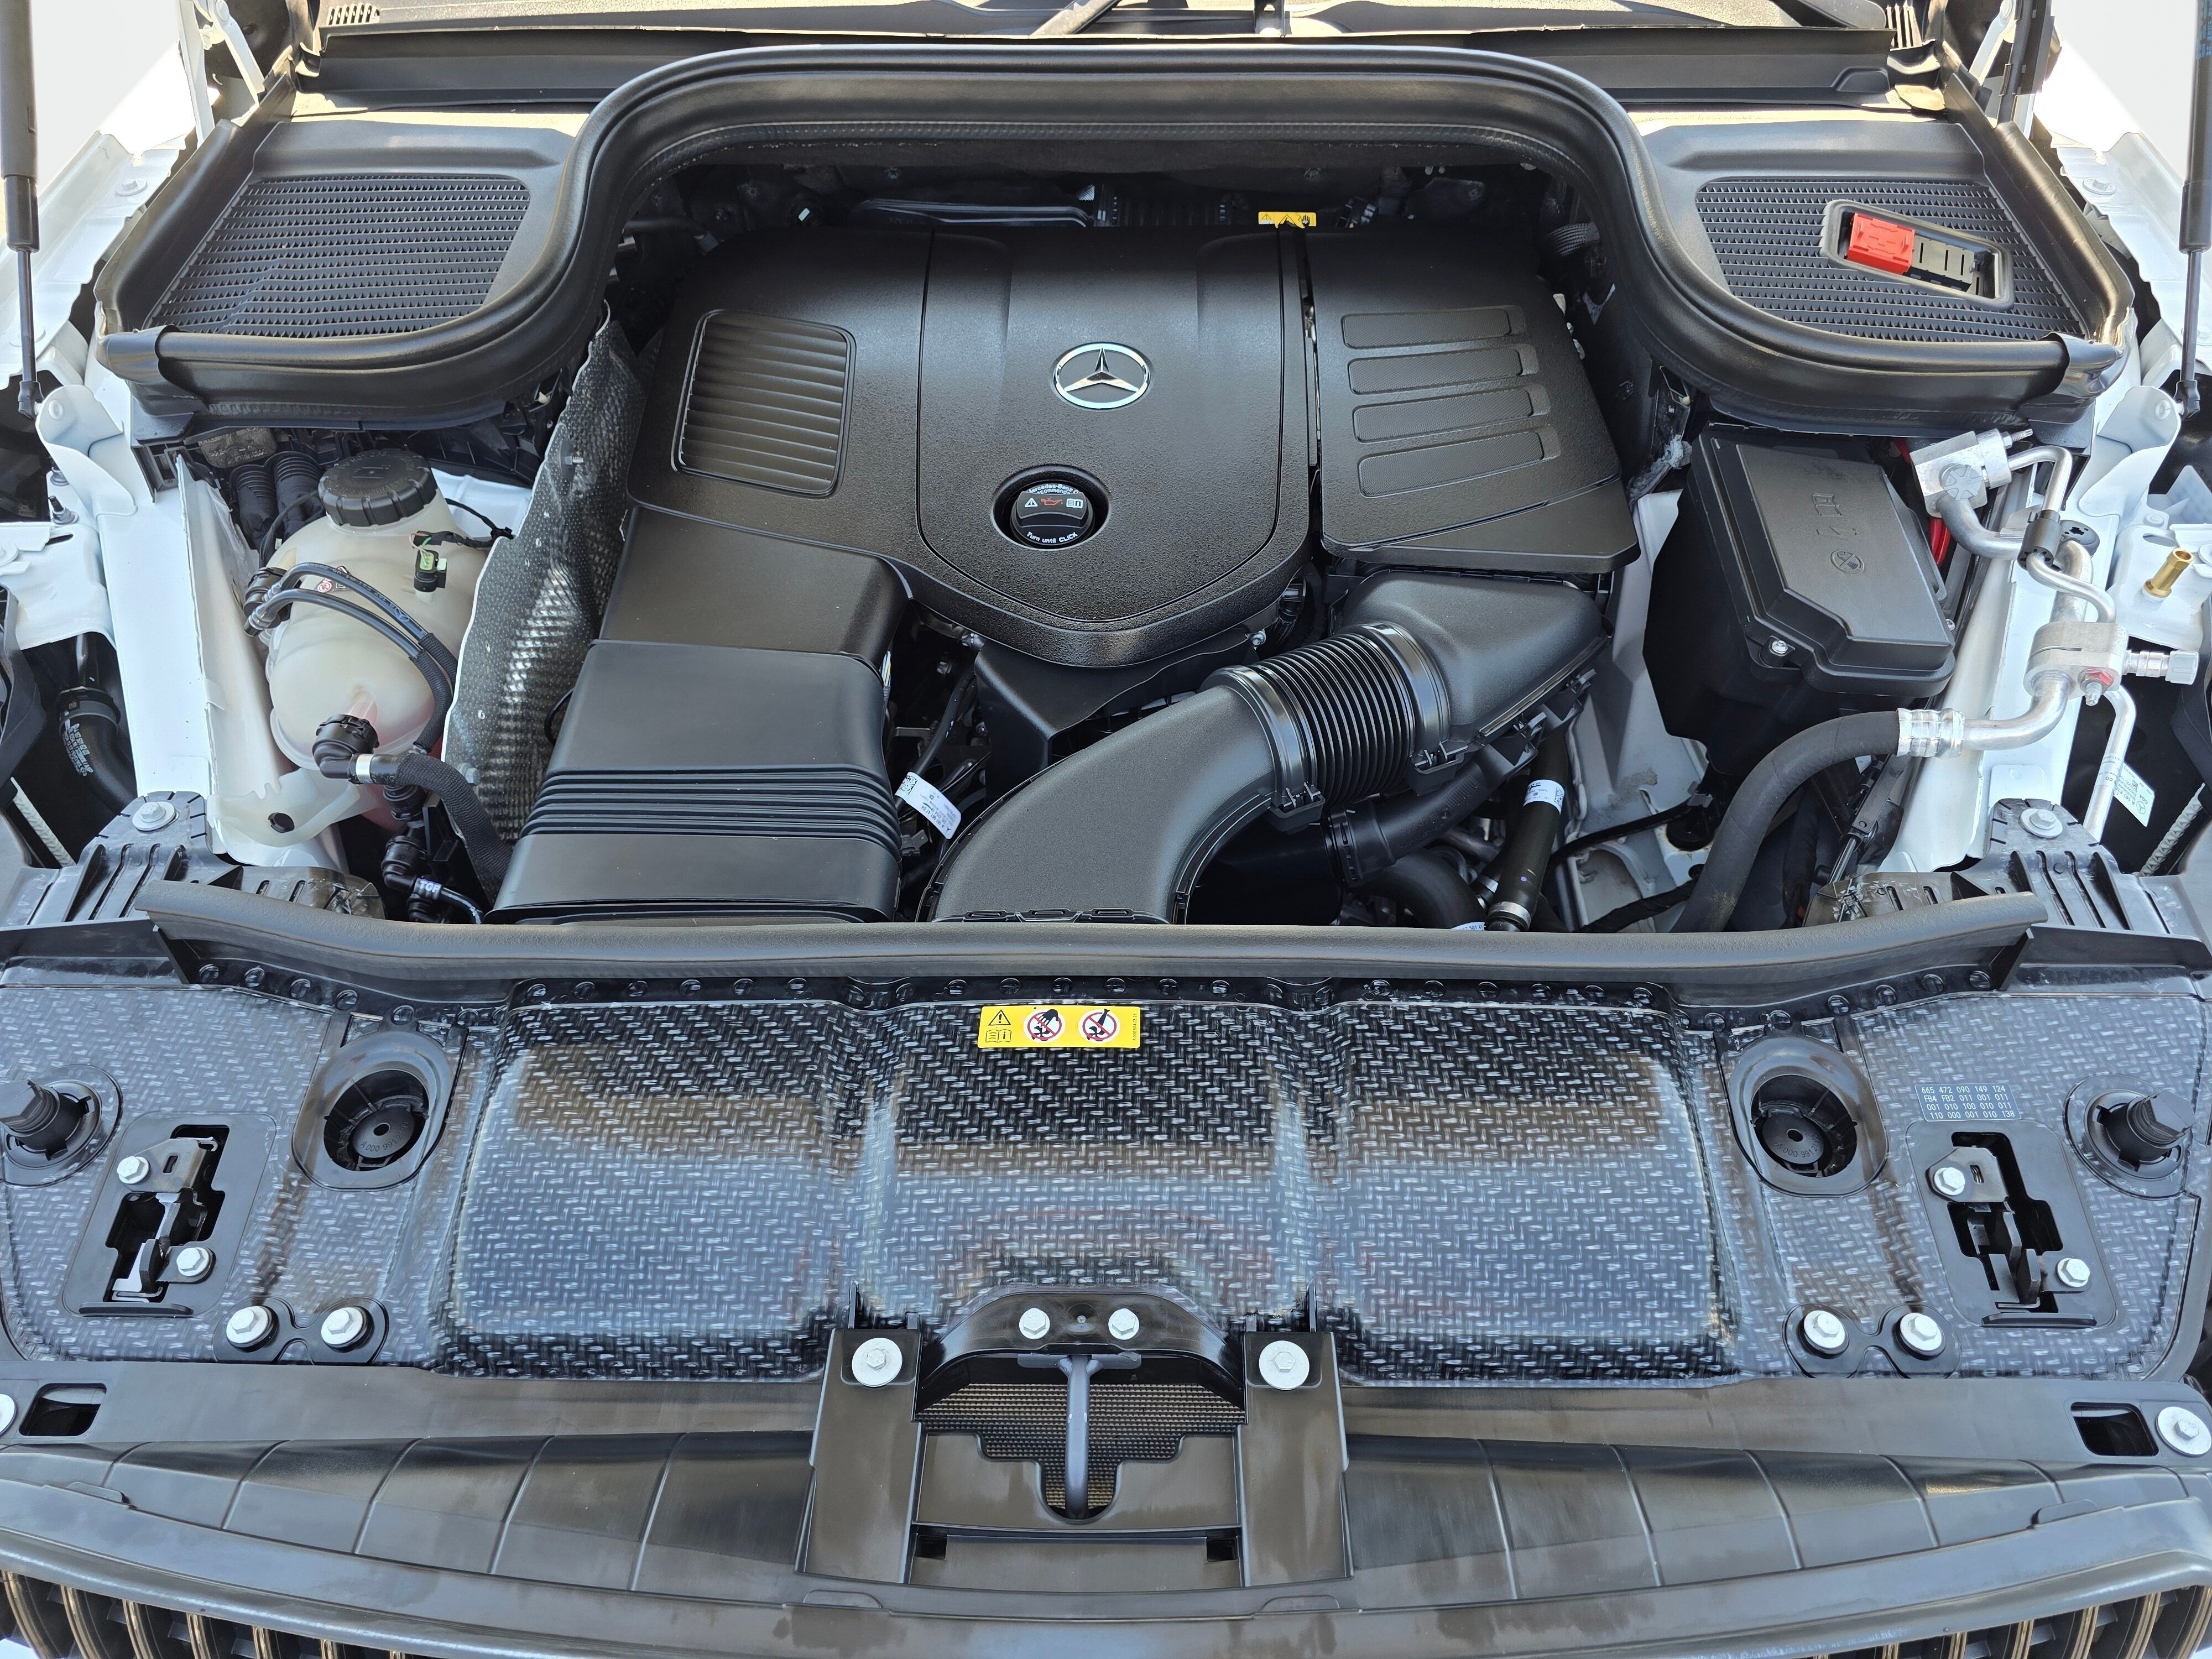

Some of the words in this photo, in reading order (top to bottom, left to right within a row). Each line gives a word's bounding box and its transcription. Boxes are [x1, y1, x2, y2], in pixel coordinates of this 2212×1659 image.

[1026, 531, 1040, 541] Turn
[1058, 531, 1078, 542] CLICK
[420, 880, 441, 893] TOP
[383, 1139, 398, 1150] 991
[1783, 1148, 1798, 1157] 000
[1801, 1149, 1815, 1158] 991
